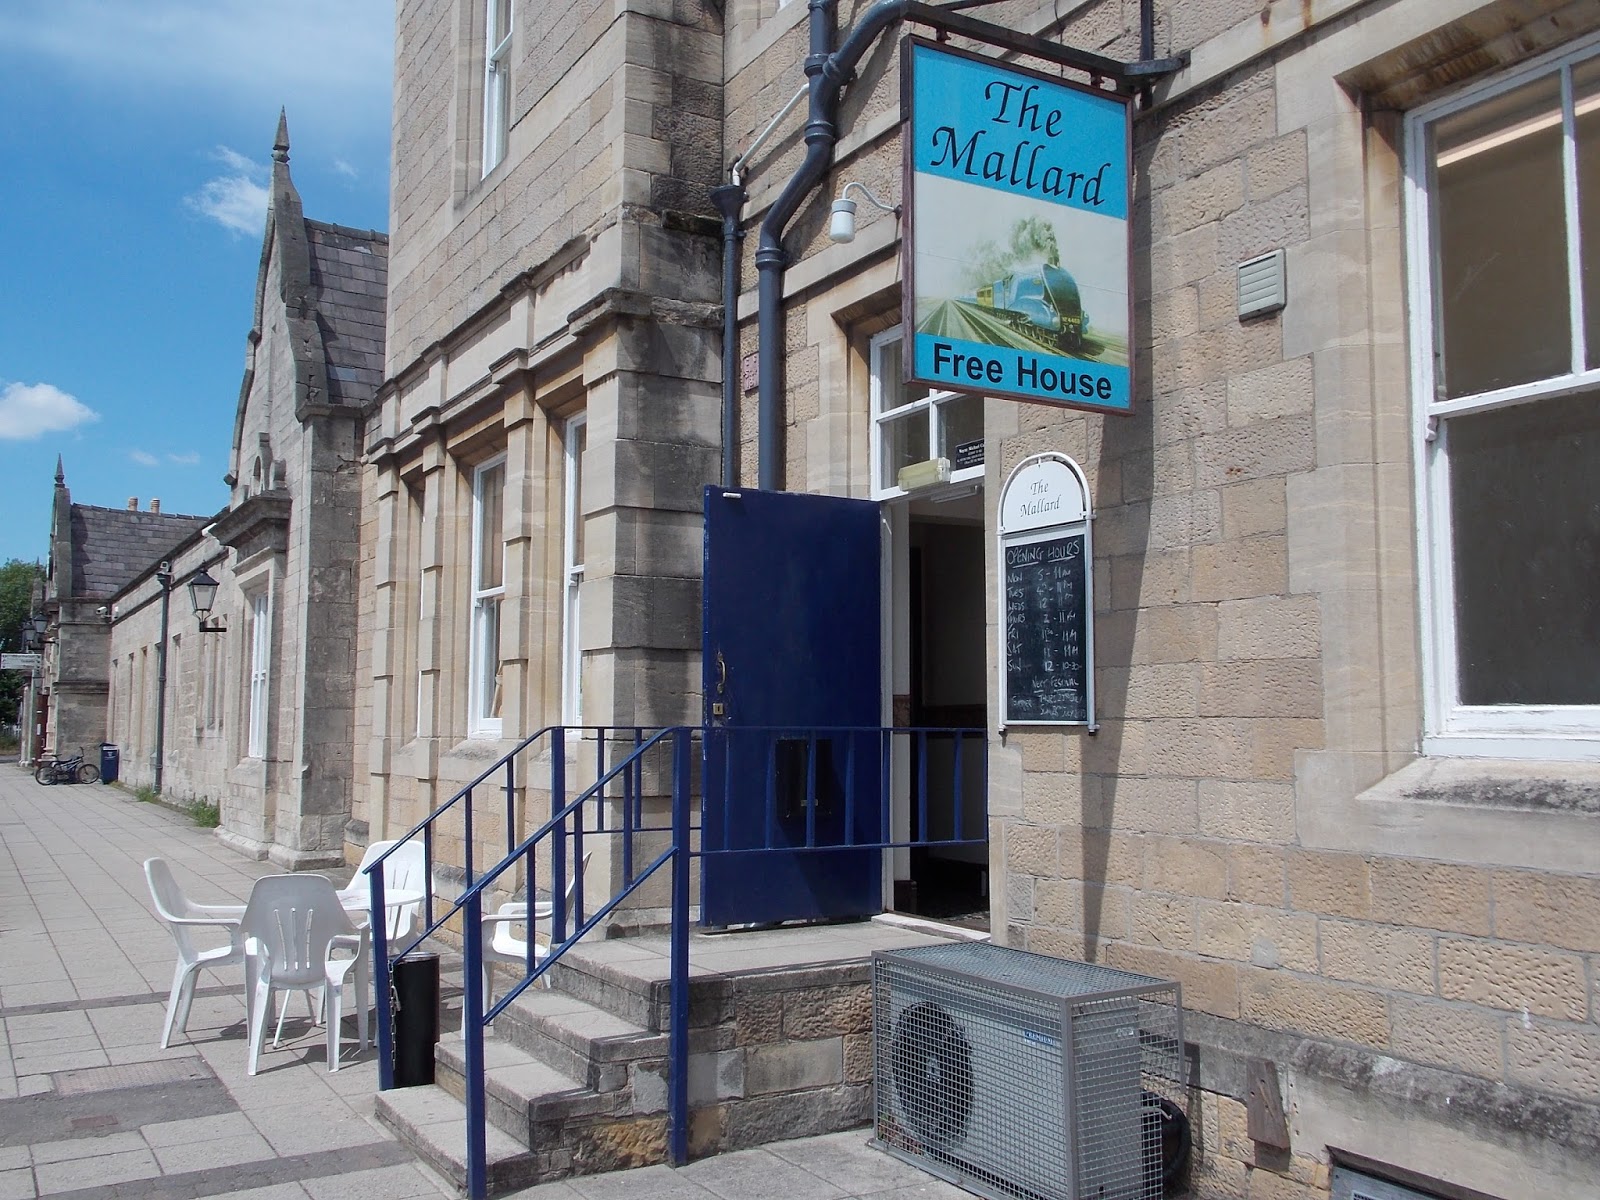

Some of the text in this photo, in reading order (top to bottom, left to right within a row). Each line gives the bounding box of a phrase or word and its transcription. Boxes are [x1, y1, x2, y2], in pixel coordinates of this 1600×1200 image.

[984, 80, 1063, 138] The
[930, 125, 1112, 206] Mallard
[933, 342, 1112, 401] Free House
[1030, 478, 1049, 495] The
[1020, 494, 1062, 518] Mallard
[1006, 539, 1080, 565] OPENING HOURS
[1007, 572, 1023, 584] MON
[1037, 568, 1044, 581] 5
[1039, 597, 1048, 609] 12
[1007, 624, 1019, 640] FRI
[1007, 641, 1023, 656] SAT
[1007, 657, 1022, 672] SUN
[1044, 660, 1055, 672] 12
